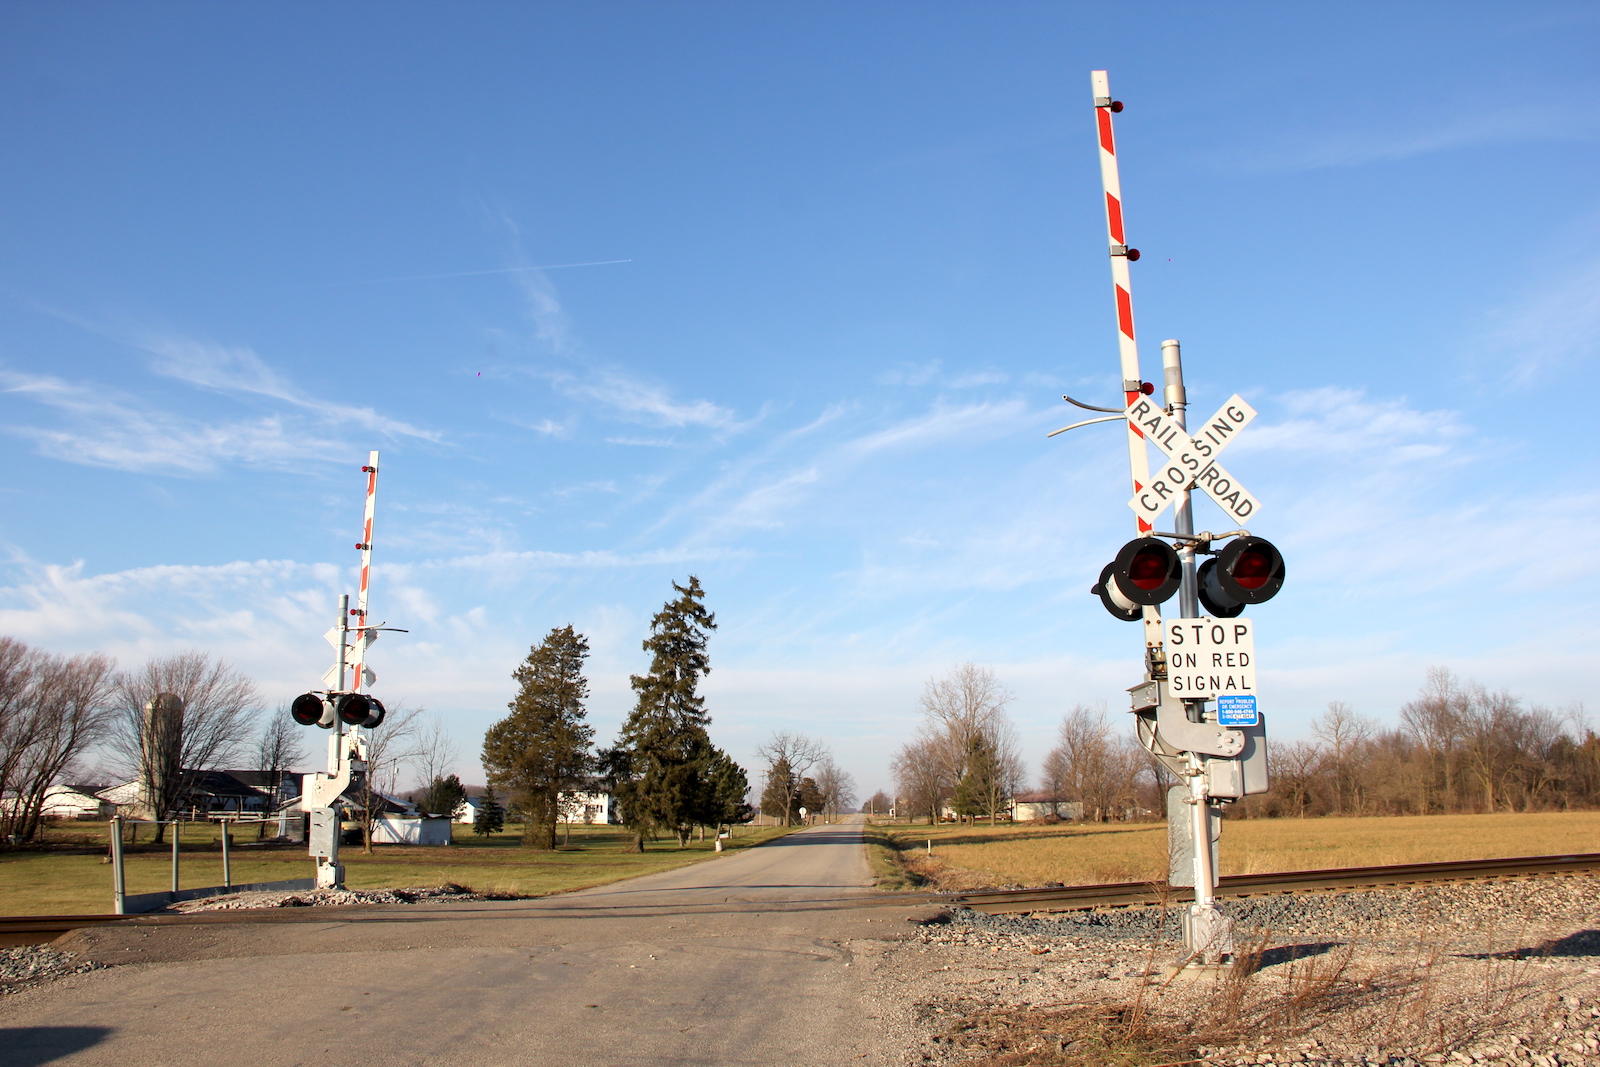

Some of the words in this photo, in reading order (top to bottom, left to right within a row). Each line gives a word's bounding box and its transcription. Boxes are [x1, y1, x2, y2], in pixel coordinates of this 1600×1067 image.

[1131, 400, 1177, 451] RAIL
[1200, 466, 1253, 517] ROAD
[1140, 406, 1245, 511] CROSSING
[1171, 624, 1248, 645] STOP
[1172, 653, 1196, 668] ON
[1212, 652, 1250, 667] RED
[1173, 675, 1251, 691] SIGNAL
